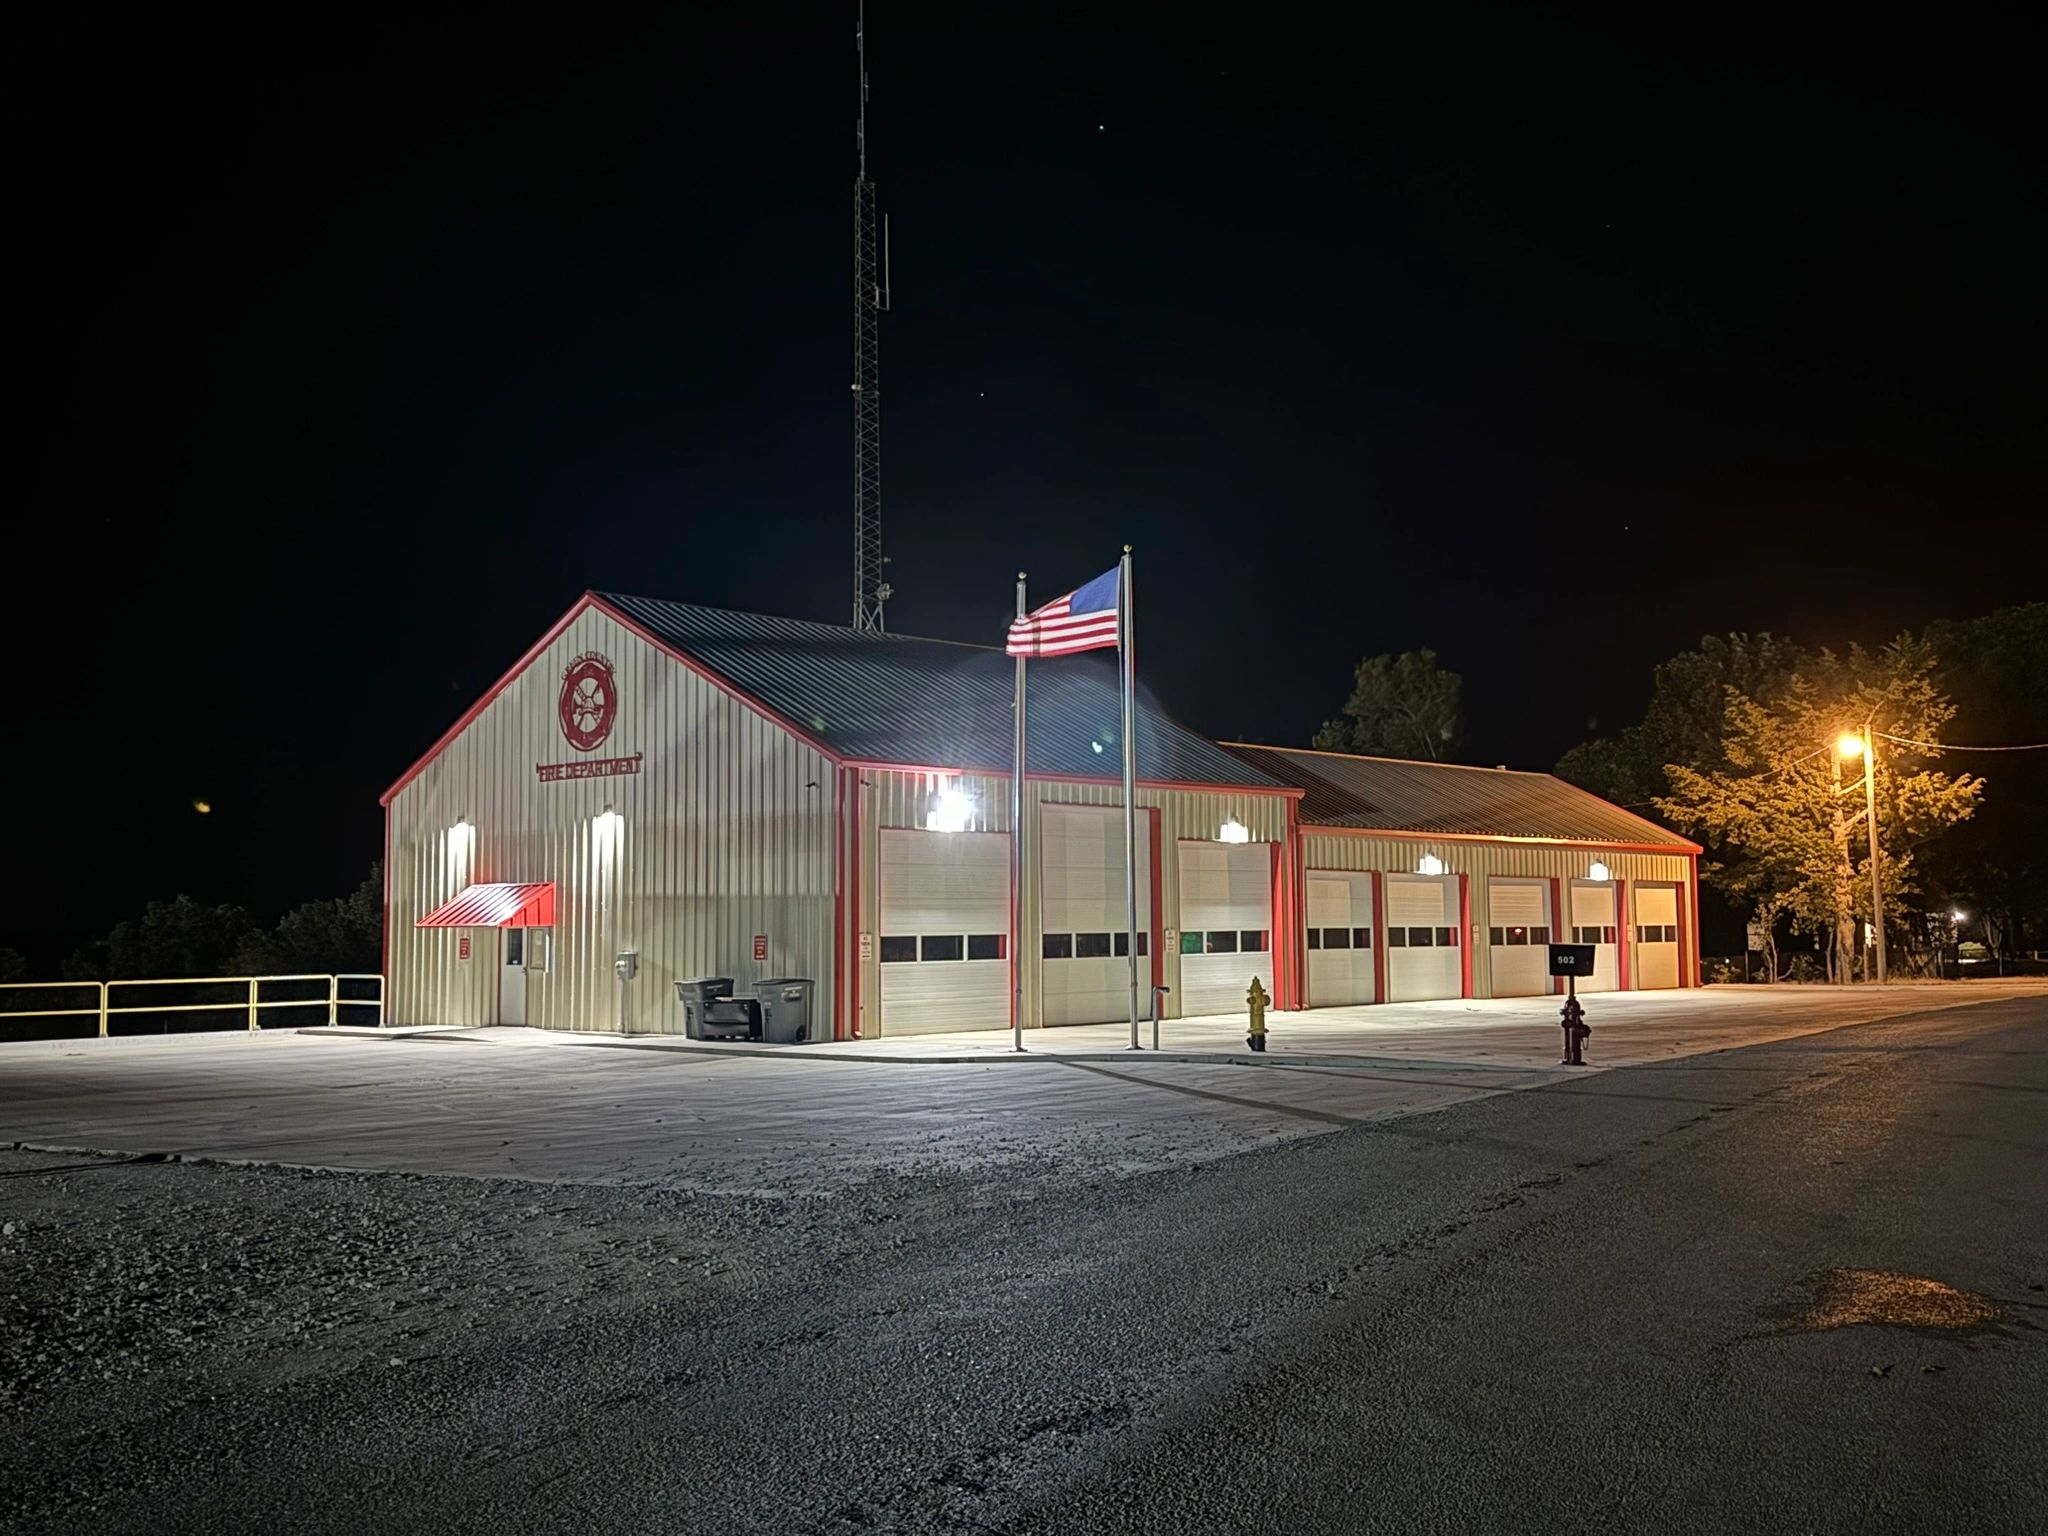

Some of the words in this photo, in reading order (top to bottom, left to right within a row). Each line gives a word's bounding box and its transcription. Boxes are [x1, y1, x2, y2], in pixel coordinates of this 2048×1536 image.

[540, 764, 565, 781] FIRE
[566, 758, 641, 778] DEPARTMENT
[1557, 956, 1575, 964] 502
